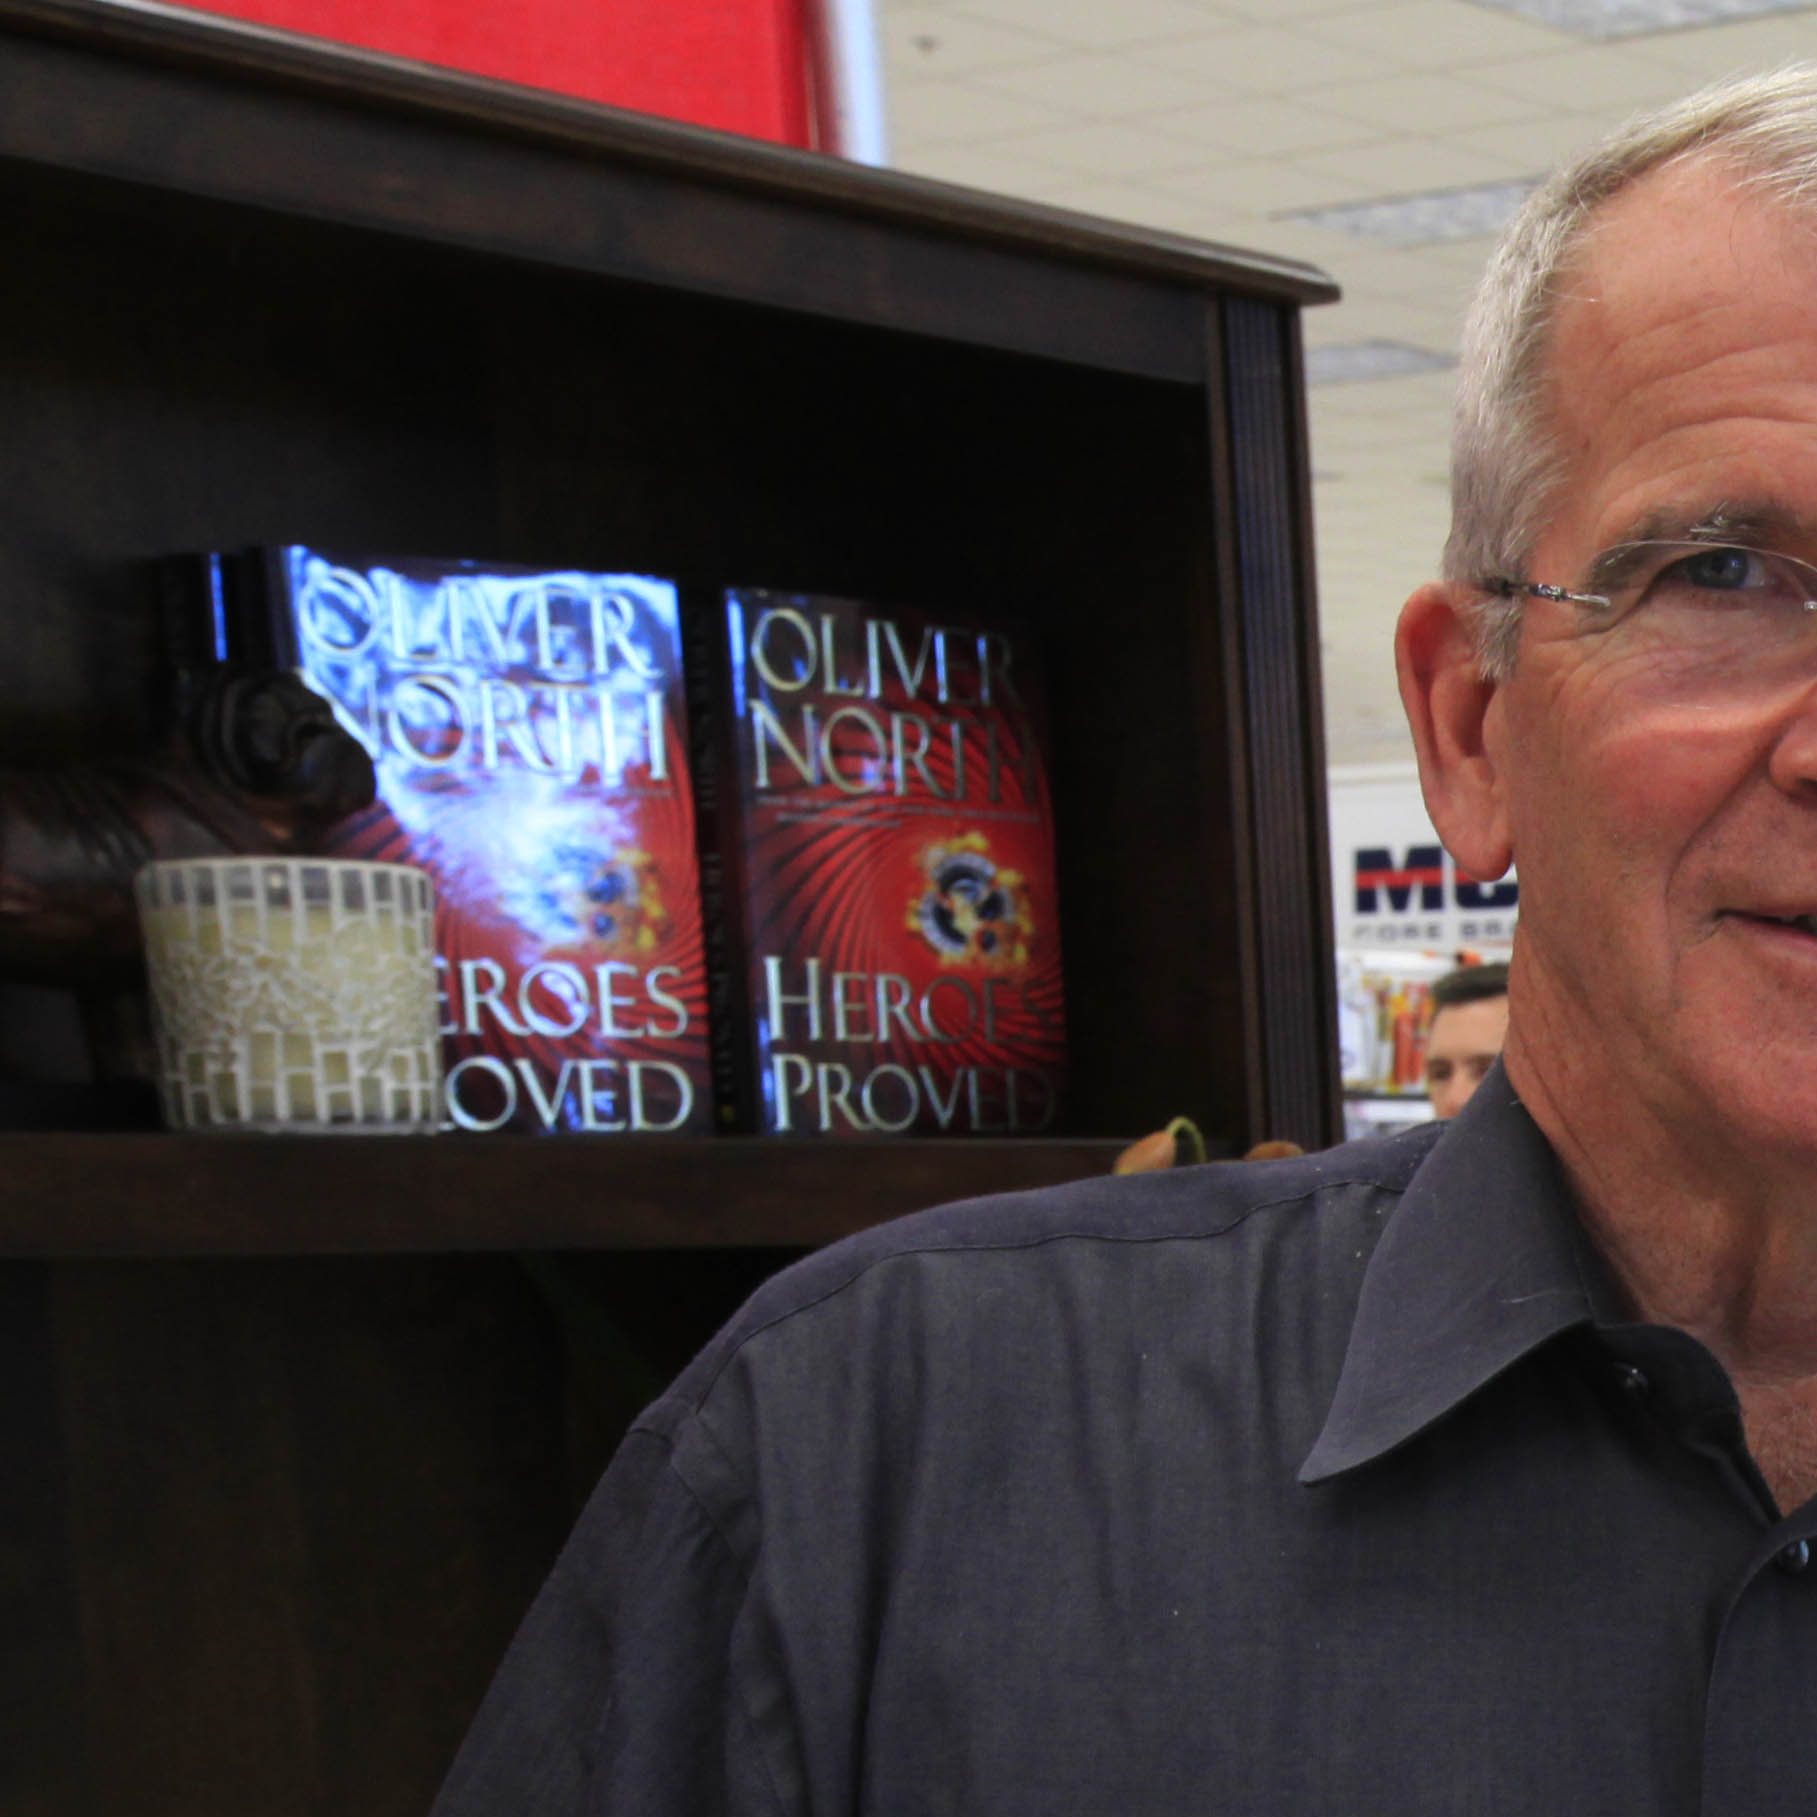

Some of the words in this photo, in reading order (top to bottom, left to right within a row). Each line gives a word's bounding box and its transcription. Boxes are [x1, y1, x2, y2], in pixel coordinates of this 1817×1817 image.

[300, 566, 664, 682] OLIVER
[749, 606, 1026, 708] OLIVER
[748, 698, 1037, 809] NORTH
[770, 1052, 1056, 1134] PROVED
